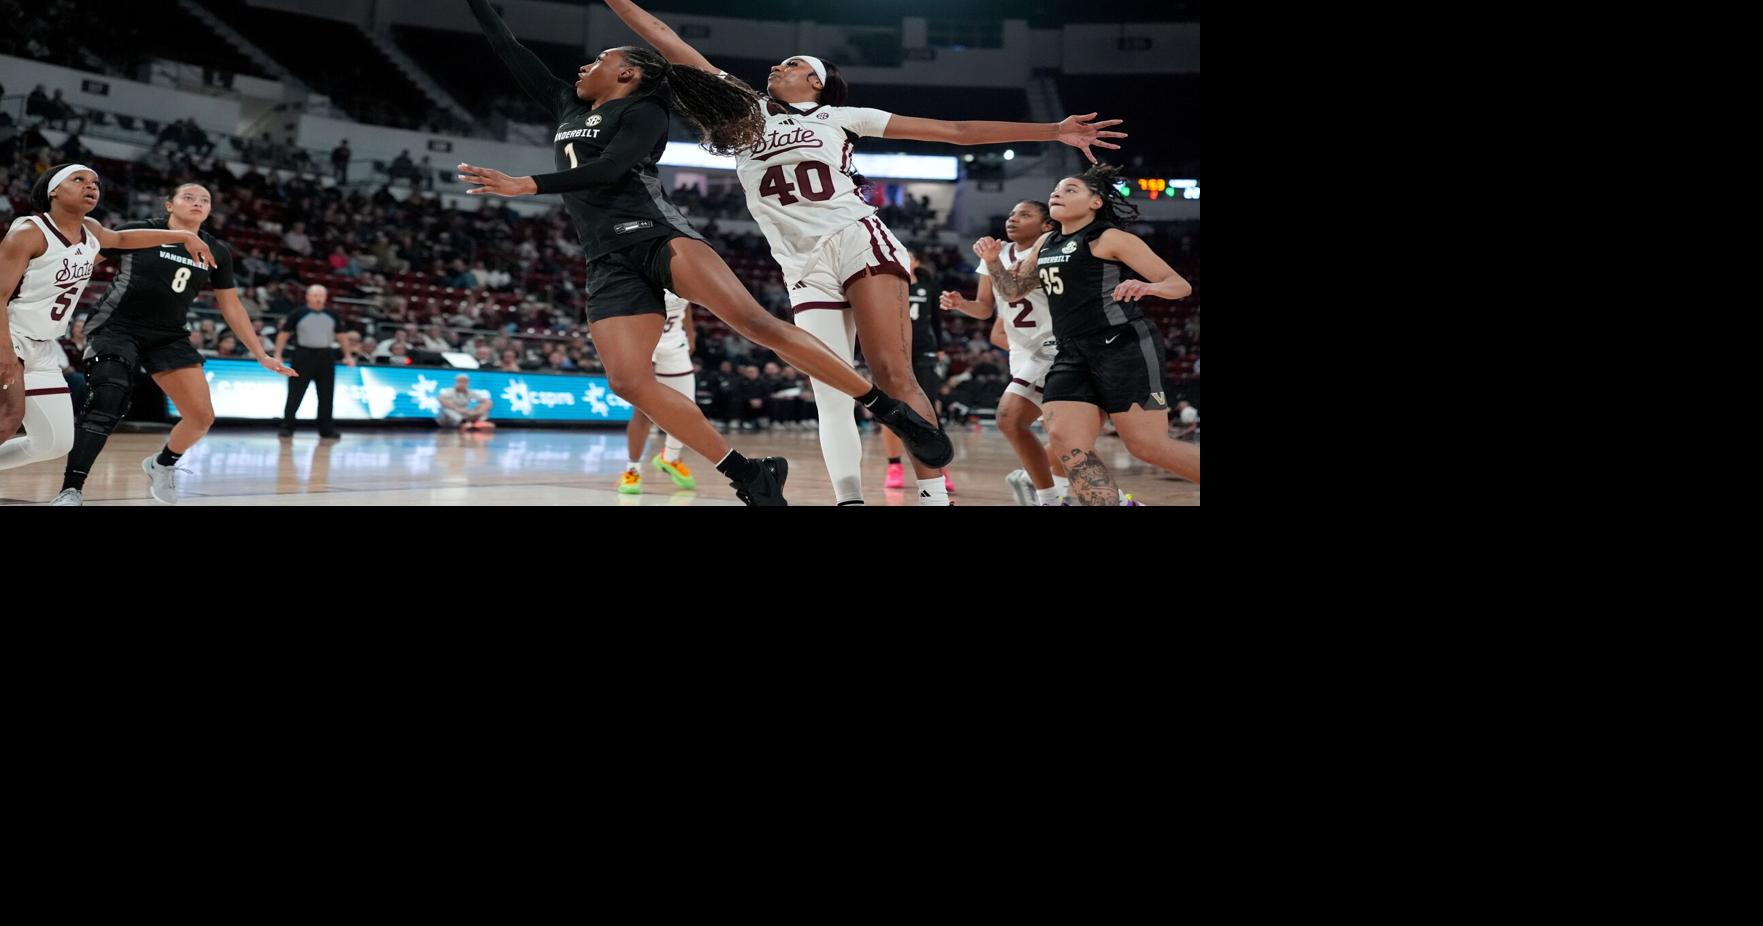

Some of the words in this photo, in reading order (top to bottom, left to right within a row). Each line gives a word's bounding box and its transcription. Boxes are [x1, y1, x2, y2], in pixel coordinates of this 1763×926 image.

[564, 142, 578, 169] 1
[759, 160, 835, 206] 40
[171, 266, 192, 293] 8
[1039, 266, 1064, 295] 35
[50, 287, 79, 321] 5
[1008, 298, 1037, 328] 2
